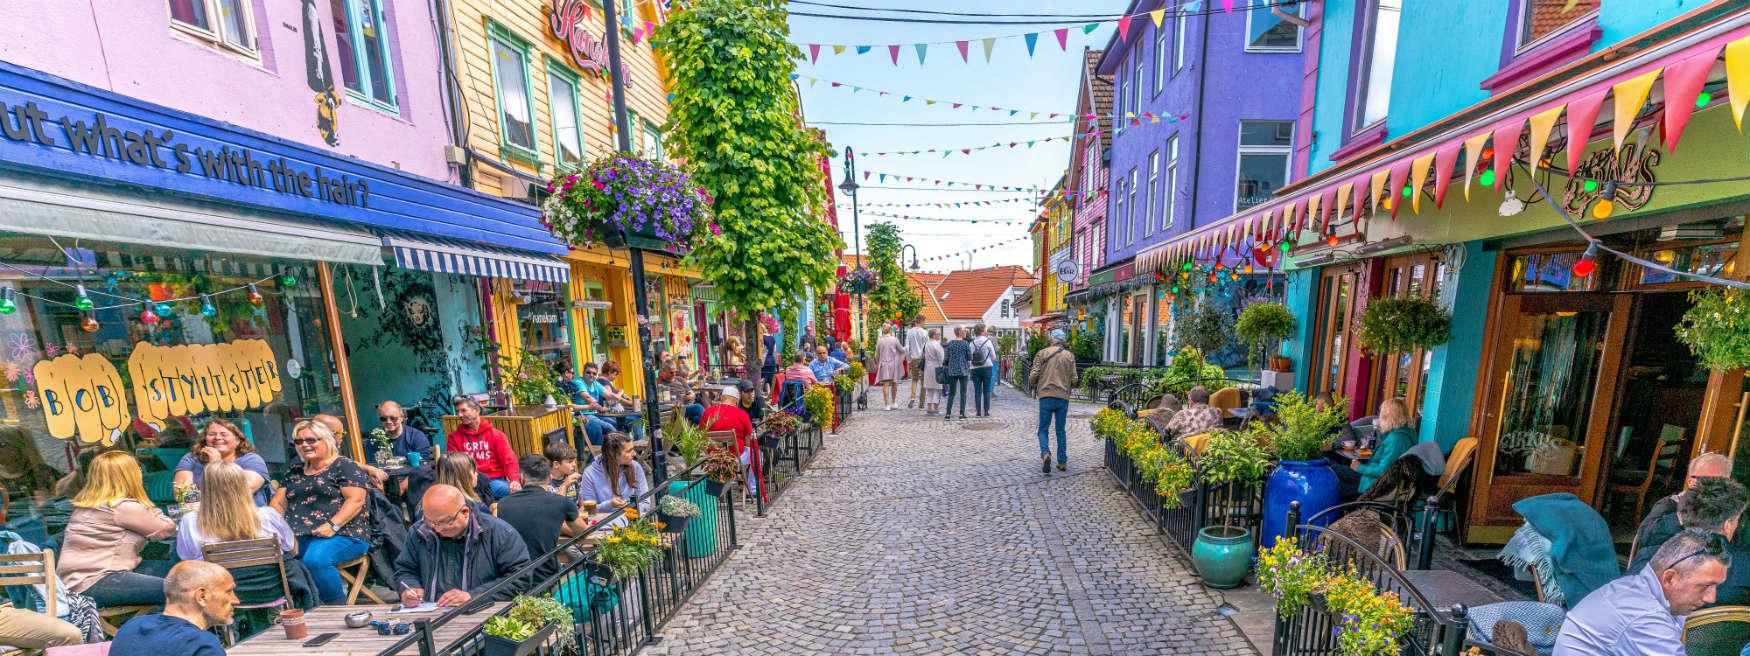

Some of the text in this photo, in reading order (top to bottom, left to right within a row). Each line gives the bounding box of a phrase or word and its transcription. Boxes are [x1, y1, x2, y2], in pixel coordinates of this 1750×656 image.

[195, 146, 266, 188] with
[267, 157, 313, 197] the
[315, 166, 369, 208] hair?
[45, 360, 279, 416] BOB STYLISTER
[463, 439, 489, 451] ORTH
